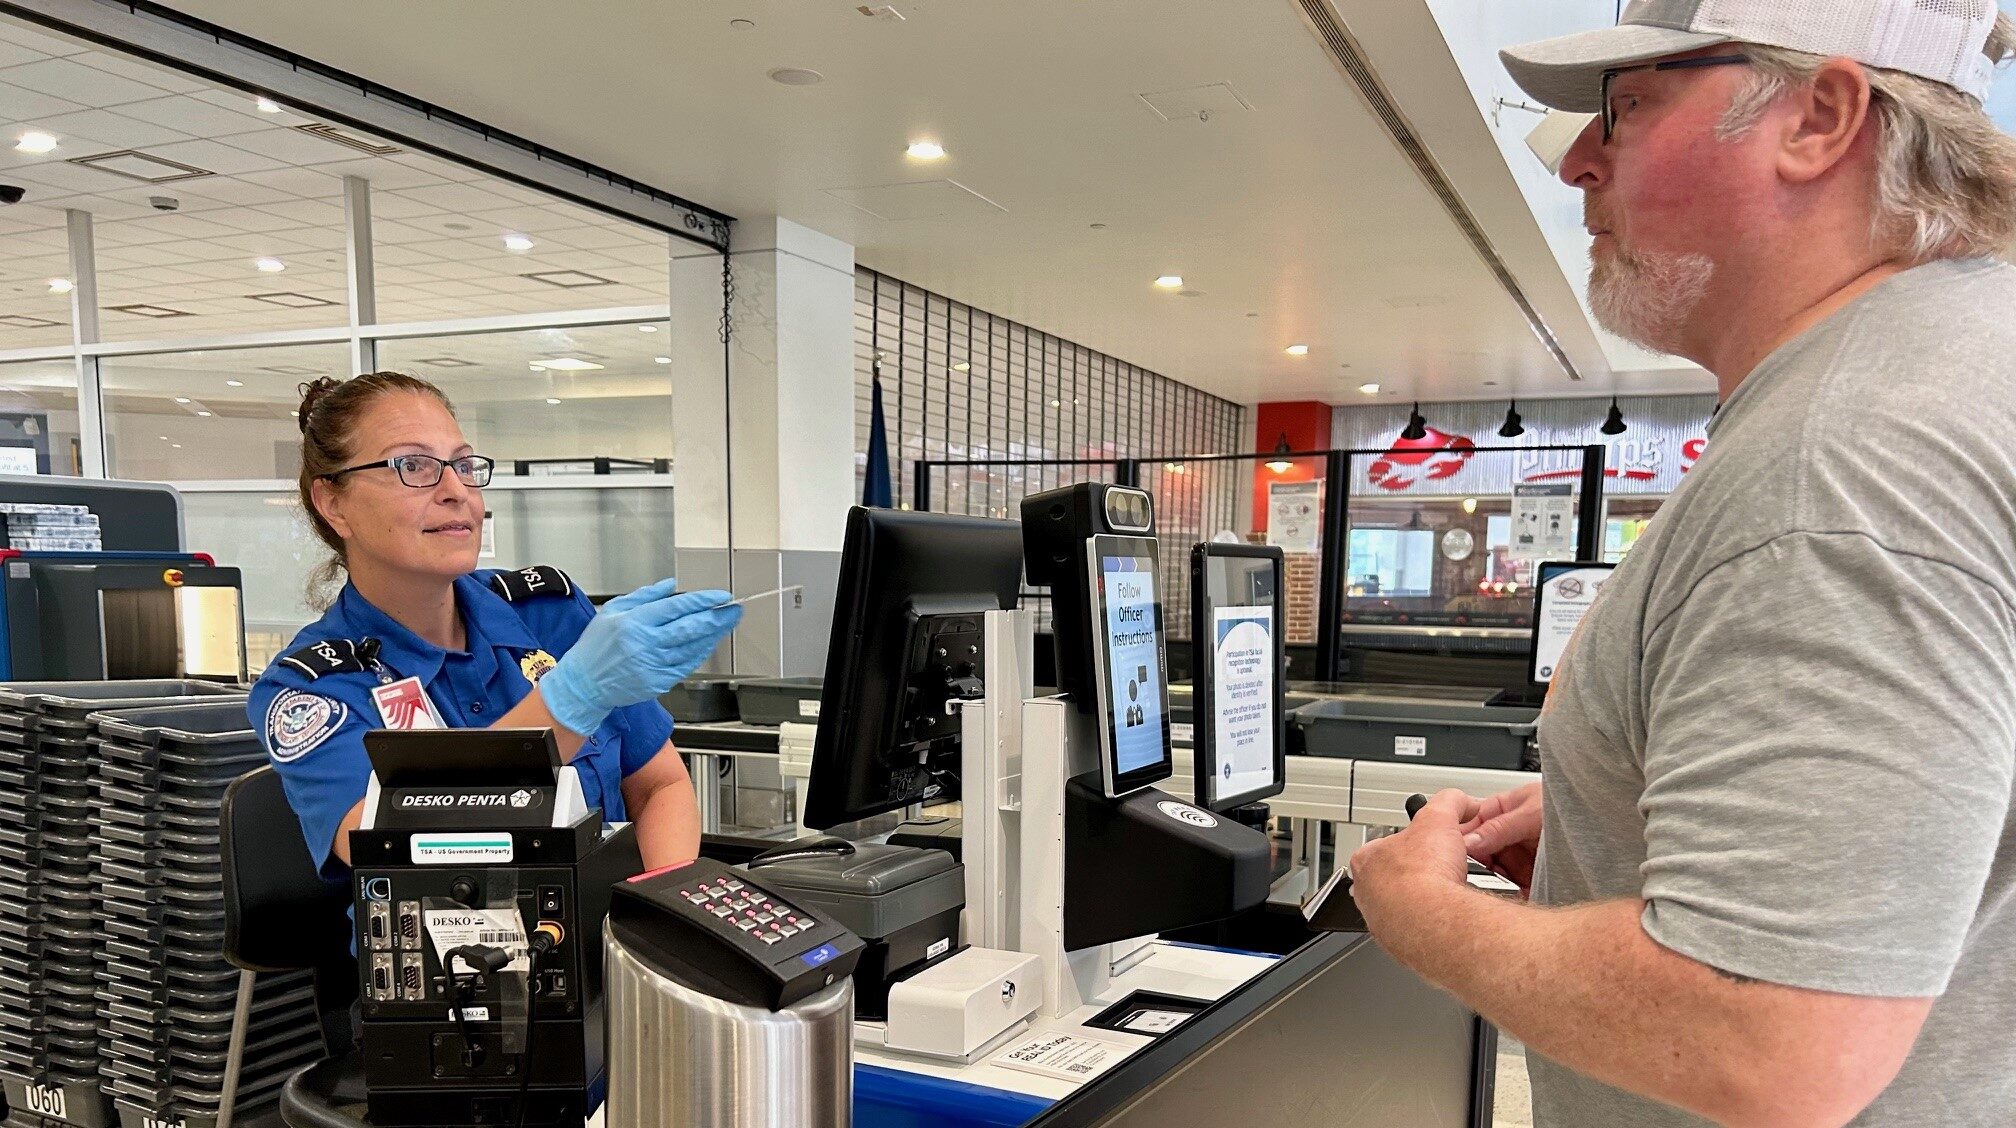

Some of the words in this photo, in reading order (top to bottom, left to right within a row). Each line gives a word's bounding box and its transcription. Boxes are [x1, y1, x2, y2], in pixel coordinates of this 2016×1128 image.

[520, 567, 545, 591] TSA
[1117, 583, 1141, 599] Follow
[1119, 606, 1143, 622] Officer
[1112, 629, 1153, 647] Instructions
[311, 641, 343, 667] TSA
[401, 795, 454, 807] DESKO
[457, 794, 506, 806] PENTA
[485, 848, 510, 856] Property
[433, 917, 471, 926] DESKO
